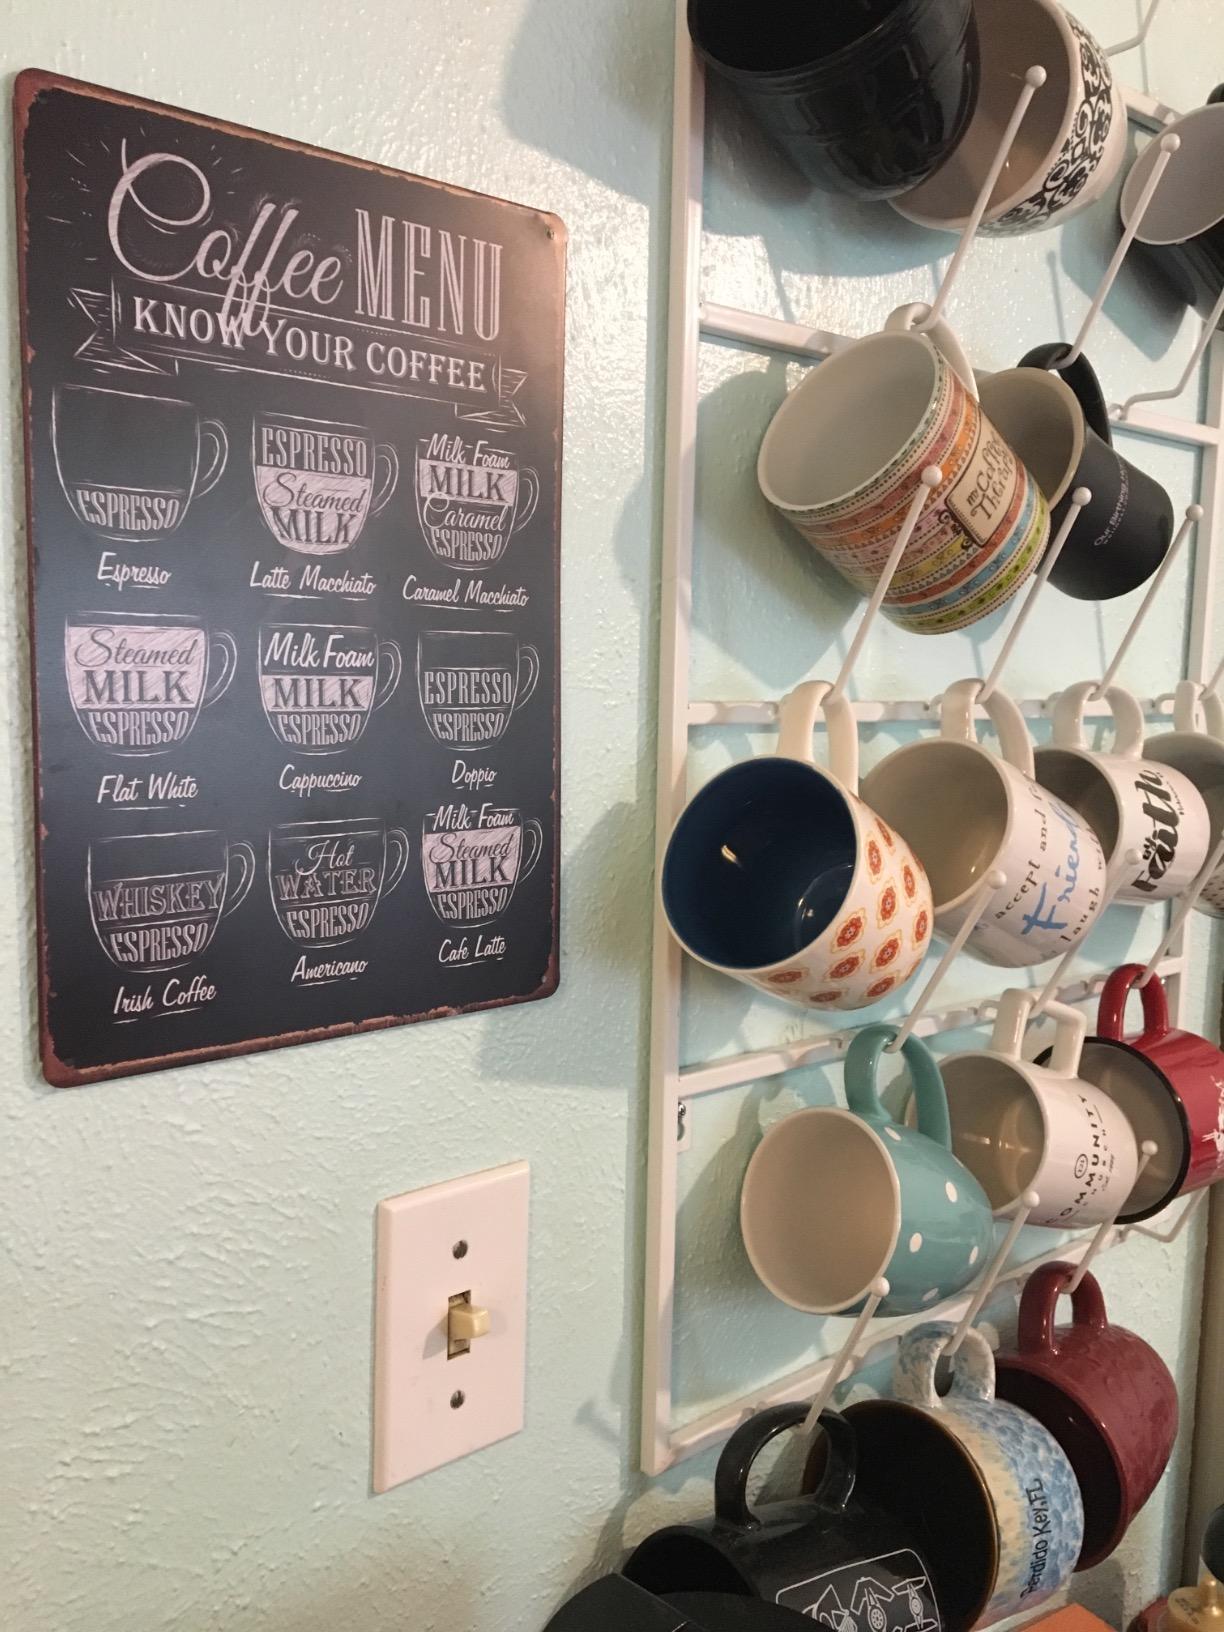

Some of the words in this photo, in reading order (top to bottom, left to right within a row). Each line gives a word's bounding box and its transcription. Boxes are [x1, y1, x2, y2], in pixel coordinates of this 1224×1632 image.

[107, 138, 343, 336] Coffee
[355, 208, 503, 341] MENU
[133, 296, 248, 351] KNOW
[258, 319, 357, 372] YOUR
[366, 343, 487, 392] COFFEE
[262, 427, 367, 477] ESPRESSO
[426, 433, 466, 464] Milk
[473, 440, 511, 469] Foam
[262, 472, 367, 513] Steamed
[429, 464, 509, 503] MILK
[76, 489, 180, 531] ESPRESSO
[270, 507, 357, 544] MILK
[423, 492, 509, 532] Caramel
[430, 528, 503, 561] ESPRESSO
[97, 552, 172, 591] Espresso
[250, 561, 291, 590] Latte
[299, 565, 376, 595] Macchiato
[402, 575, 460, 603] Caramel
[464, 580, 529, 607] Macchiato
[74, 628, 198, 668] Steamed
[264, 632, 320, 668] Milk
[323, 634, 375, 668] Foam
[82, 669, 195, 705] MILK
[271, 677, 365, 710] MILK
[424, 671, 512, 705] ESPRESSO
[88, 711, 189, 746] ESPRESSO
[277, 713, 361, 745] ESPRESSO
[432, 712, 504, 742] ESPRESSO
[97, 774, 143, 804] Flat
[148, 772, 198, 800] White
[279, 764, 363, 797] Cappuccino
[452, 760, 497, 790] Doppio
[432, 803, 472, 832] Milk
[478, 803, 514, 829] Foam
[295, 839, 355, 875] Hot
[429, 832, 514, 864] Steamed
[994, 859, 1041, 920] accept
[1034, 808, 1048, 852] and
[275, 867, 377, 901] WATER
[433, 855, 511, 890] MILK
[93, 872, 226, 921] WHISKEY
[437, 887, 508, 920] ESPRESSO
[286, 902, 370, 939] ESPRESSO
[1060, 887, 1100, 943] laugh
[110, 922, 208, 963] ESPRESSO
[438, 937, 469, 963] Cafe
[474, 935, 507, 958] Latte
[291, 955, 368, 983] Americano
[113, 985, 154, 1014] Irish
[162, 974, 217, 1007] Coffee
[1045, 1094, 1101, 1225] COMMUNITY
